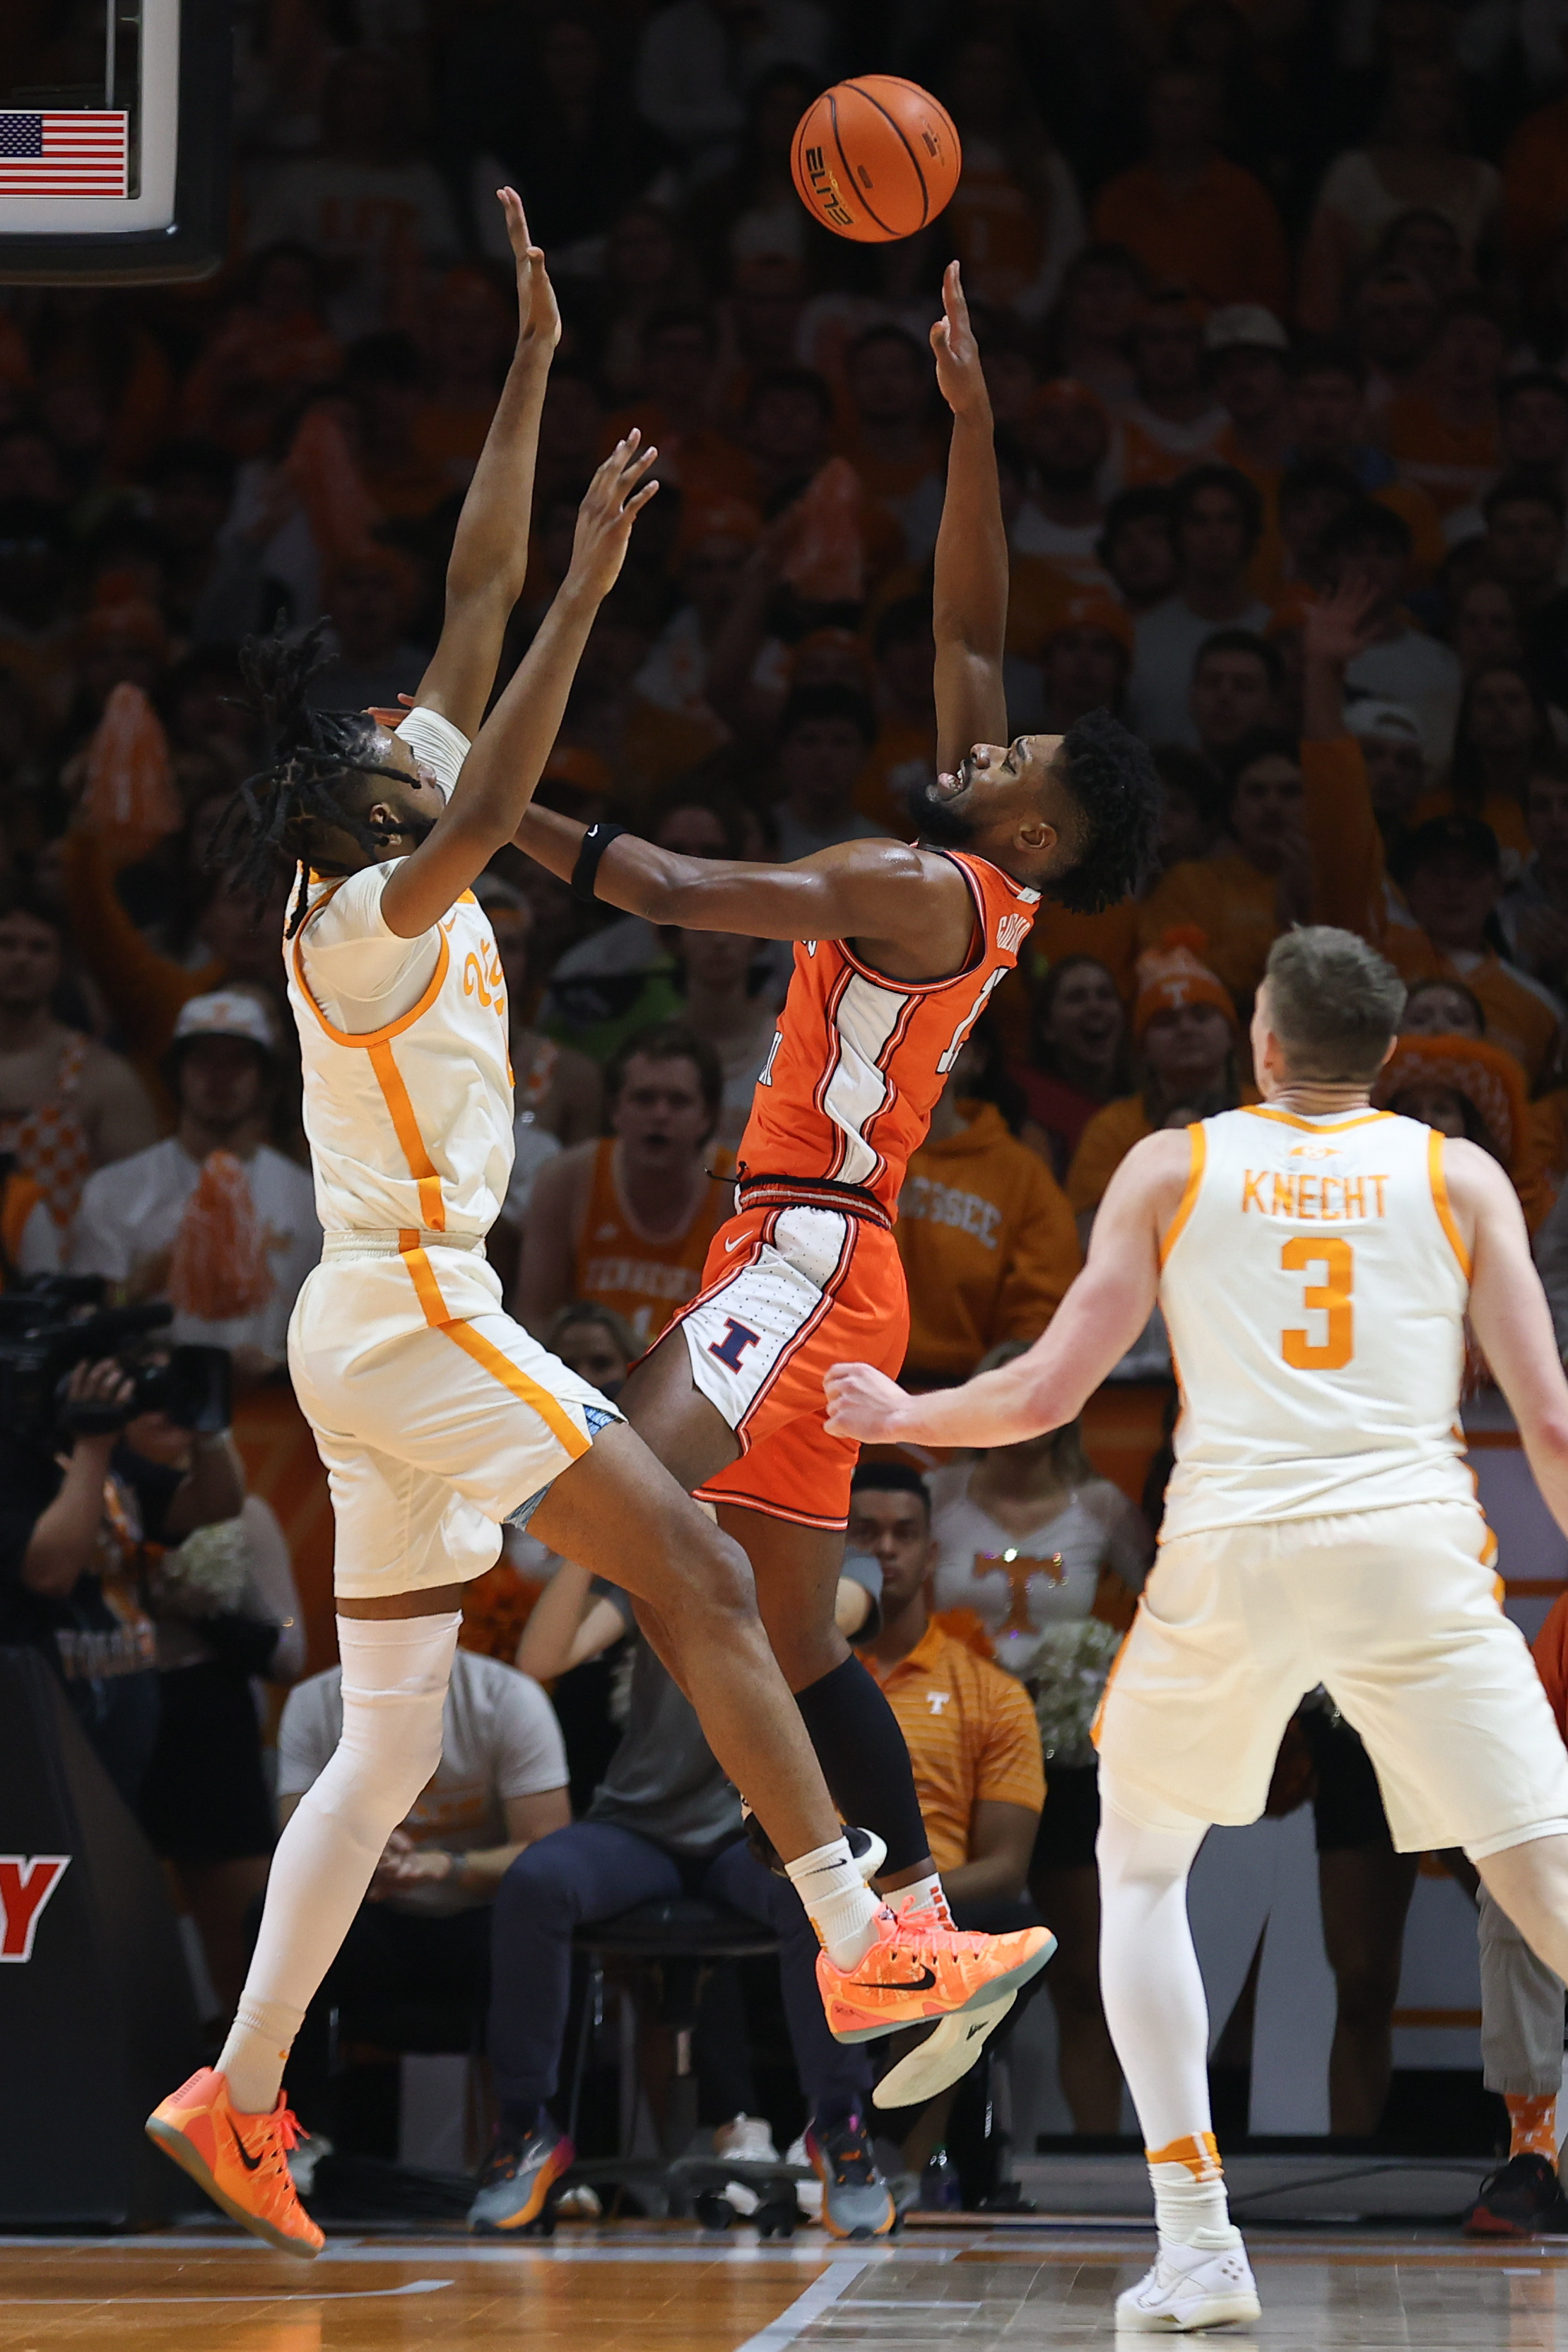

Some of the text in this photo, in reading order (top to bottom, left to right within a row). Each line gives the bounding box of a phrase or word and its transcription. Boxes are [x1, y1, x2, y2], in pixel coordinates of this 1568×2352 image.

[806, 146, 854, 226] ELITE
[1242, 1169, 1390, 1221] KNECHT
[1281, 1237, 1353, 1370] 3
[707, 1317, 761, 1374] I
[972, 1551, 1066, 1637] T
[926, 1691, 950, 1715] T
[0, 1853, 73, 1963] Y
